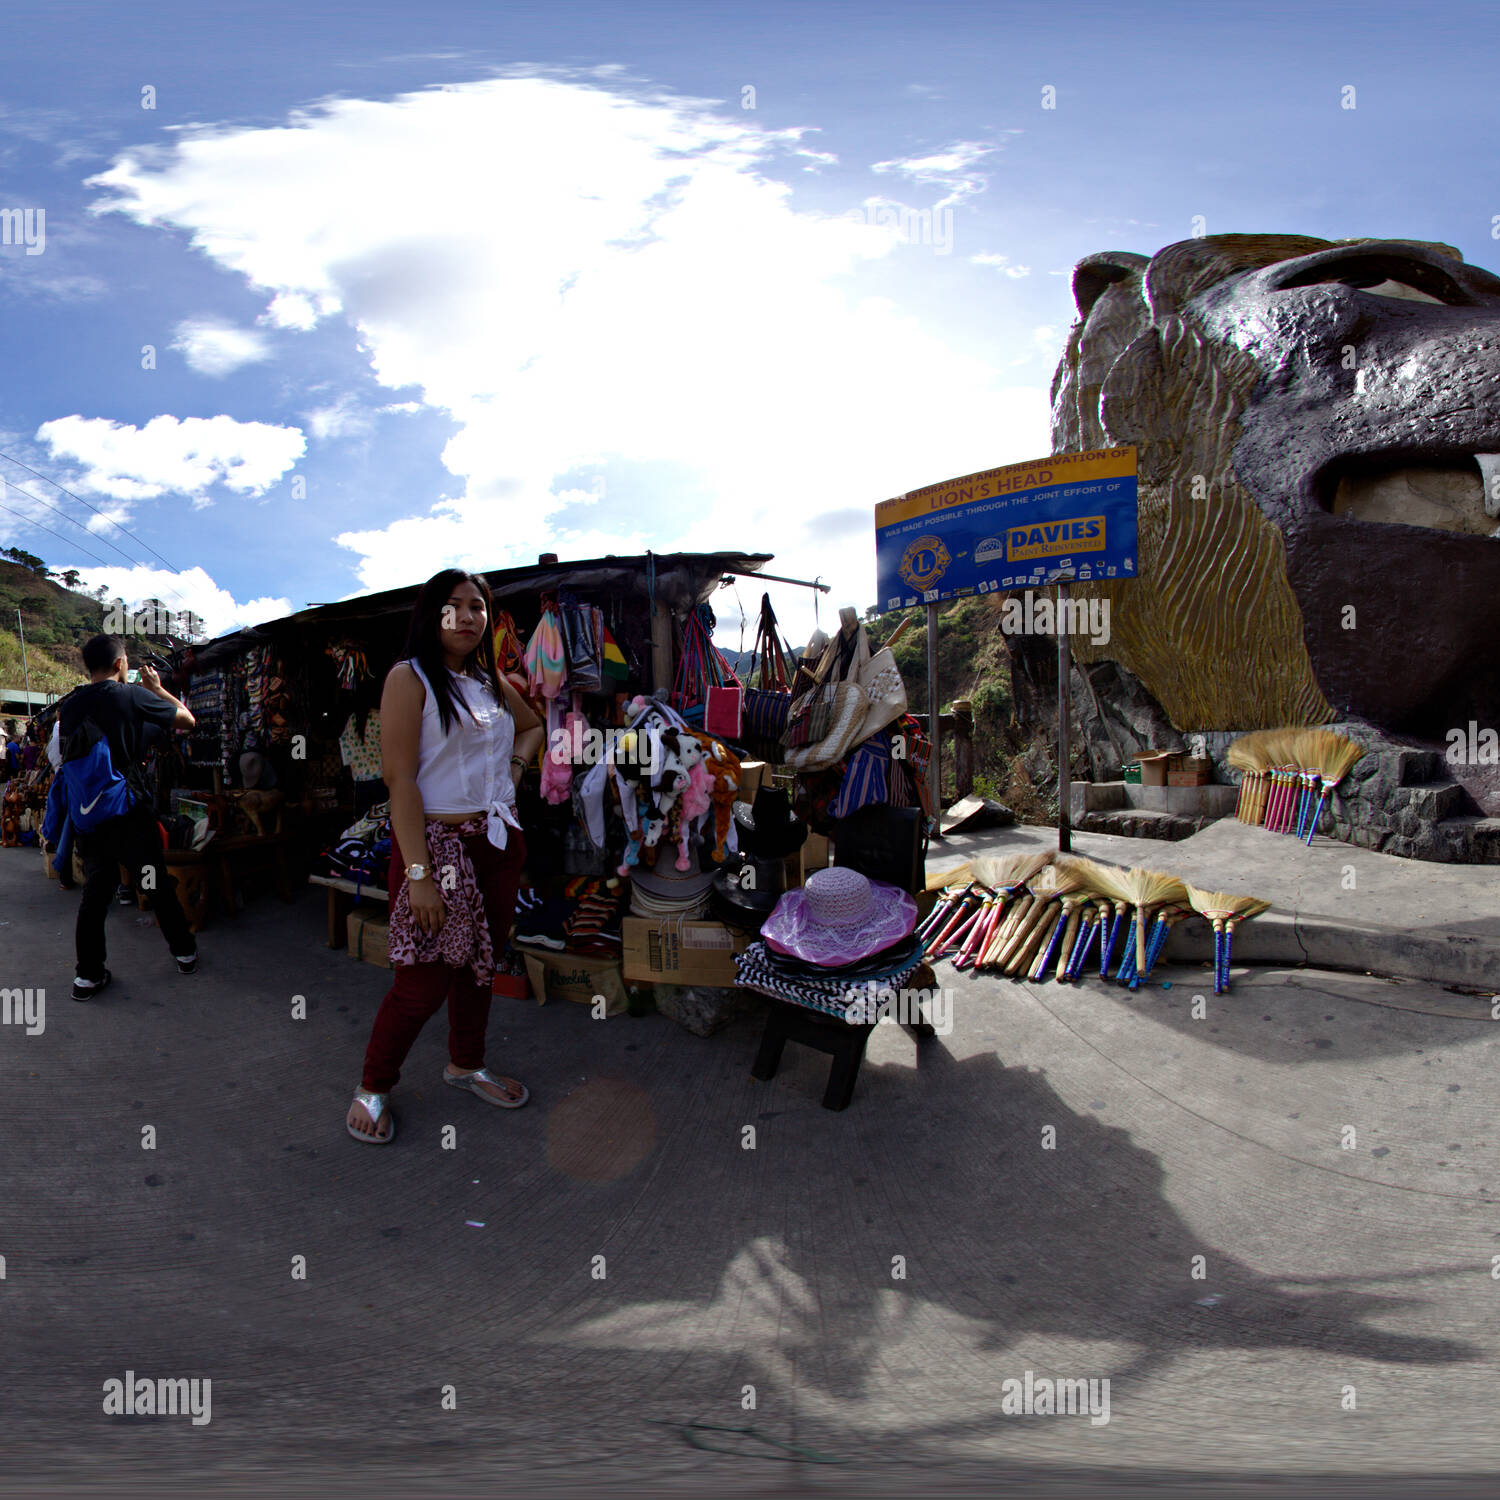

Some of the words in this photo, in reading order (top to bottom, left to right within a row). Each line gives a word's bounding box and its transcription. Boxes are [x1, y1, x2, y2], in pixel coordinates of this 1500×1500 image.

[975, 469, 1002, 480] AND
[1005, 452, 1106, 474] PRESERVATION
[1111, 449, 1130, 458] OF
[930, 483, 990, 509] LION'S
[997, 471, 1053, 492] HEAD
[885, 528, 900, 538] WAS
[902, 522, 922, 532] MADE
[924, 510, 964, 526] POSSIBLE
[966, 500, 1008, 515] THROUGH
[1011, 496, 1029, 505] THE
[1032, 491, 1060, 502] JOINT
[1063, 485, 1103, 497] EFFORT
[1106, 483, 1121, 492] OF
[1011, 520, 1100, 548] DAVIES
